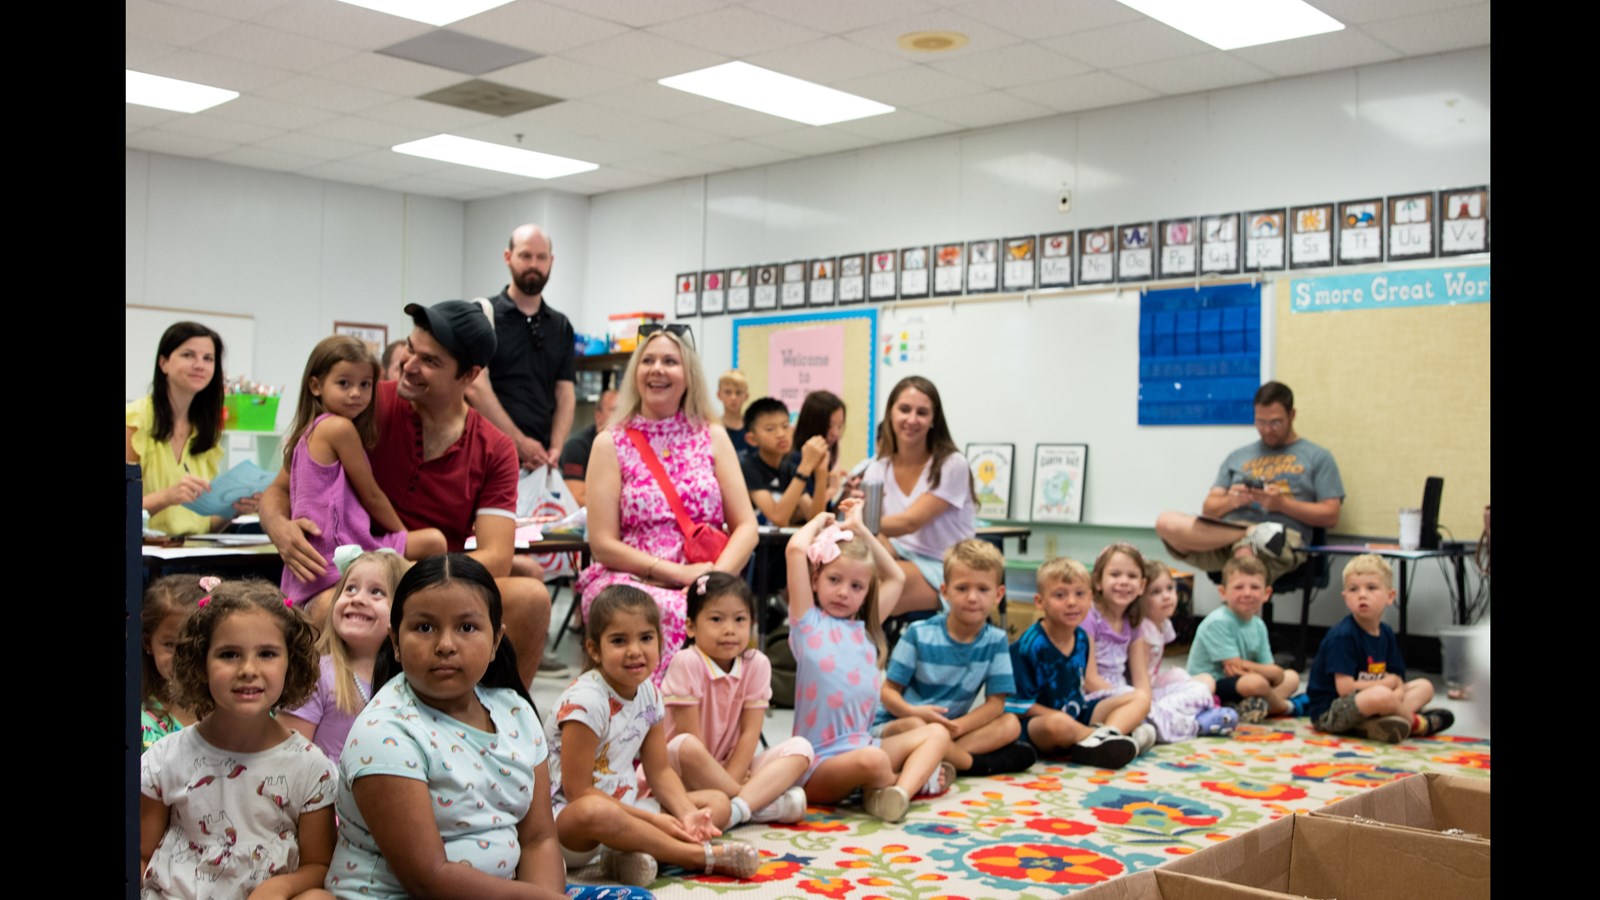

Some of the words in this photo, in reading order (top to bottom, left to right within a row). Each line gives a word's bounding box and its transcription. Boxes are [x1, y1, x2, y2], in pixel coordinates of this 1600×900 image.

[1295, 281, 1363, 307] S'more
[1370, 276, 1435, 302] Great
[782, 353, 830, 367] Welcome
[799, 371, 811, 383] to
